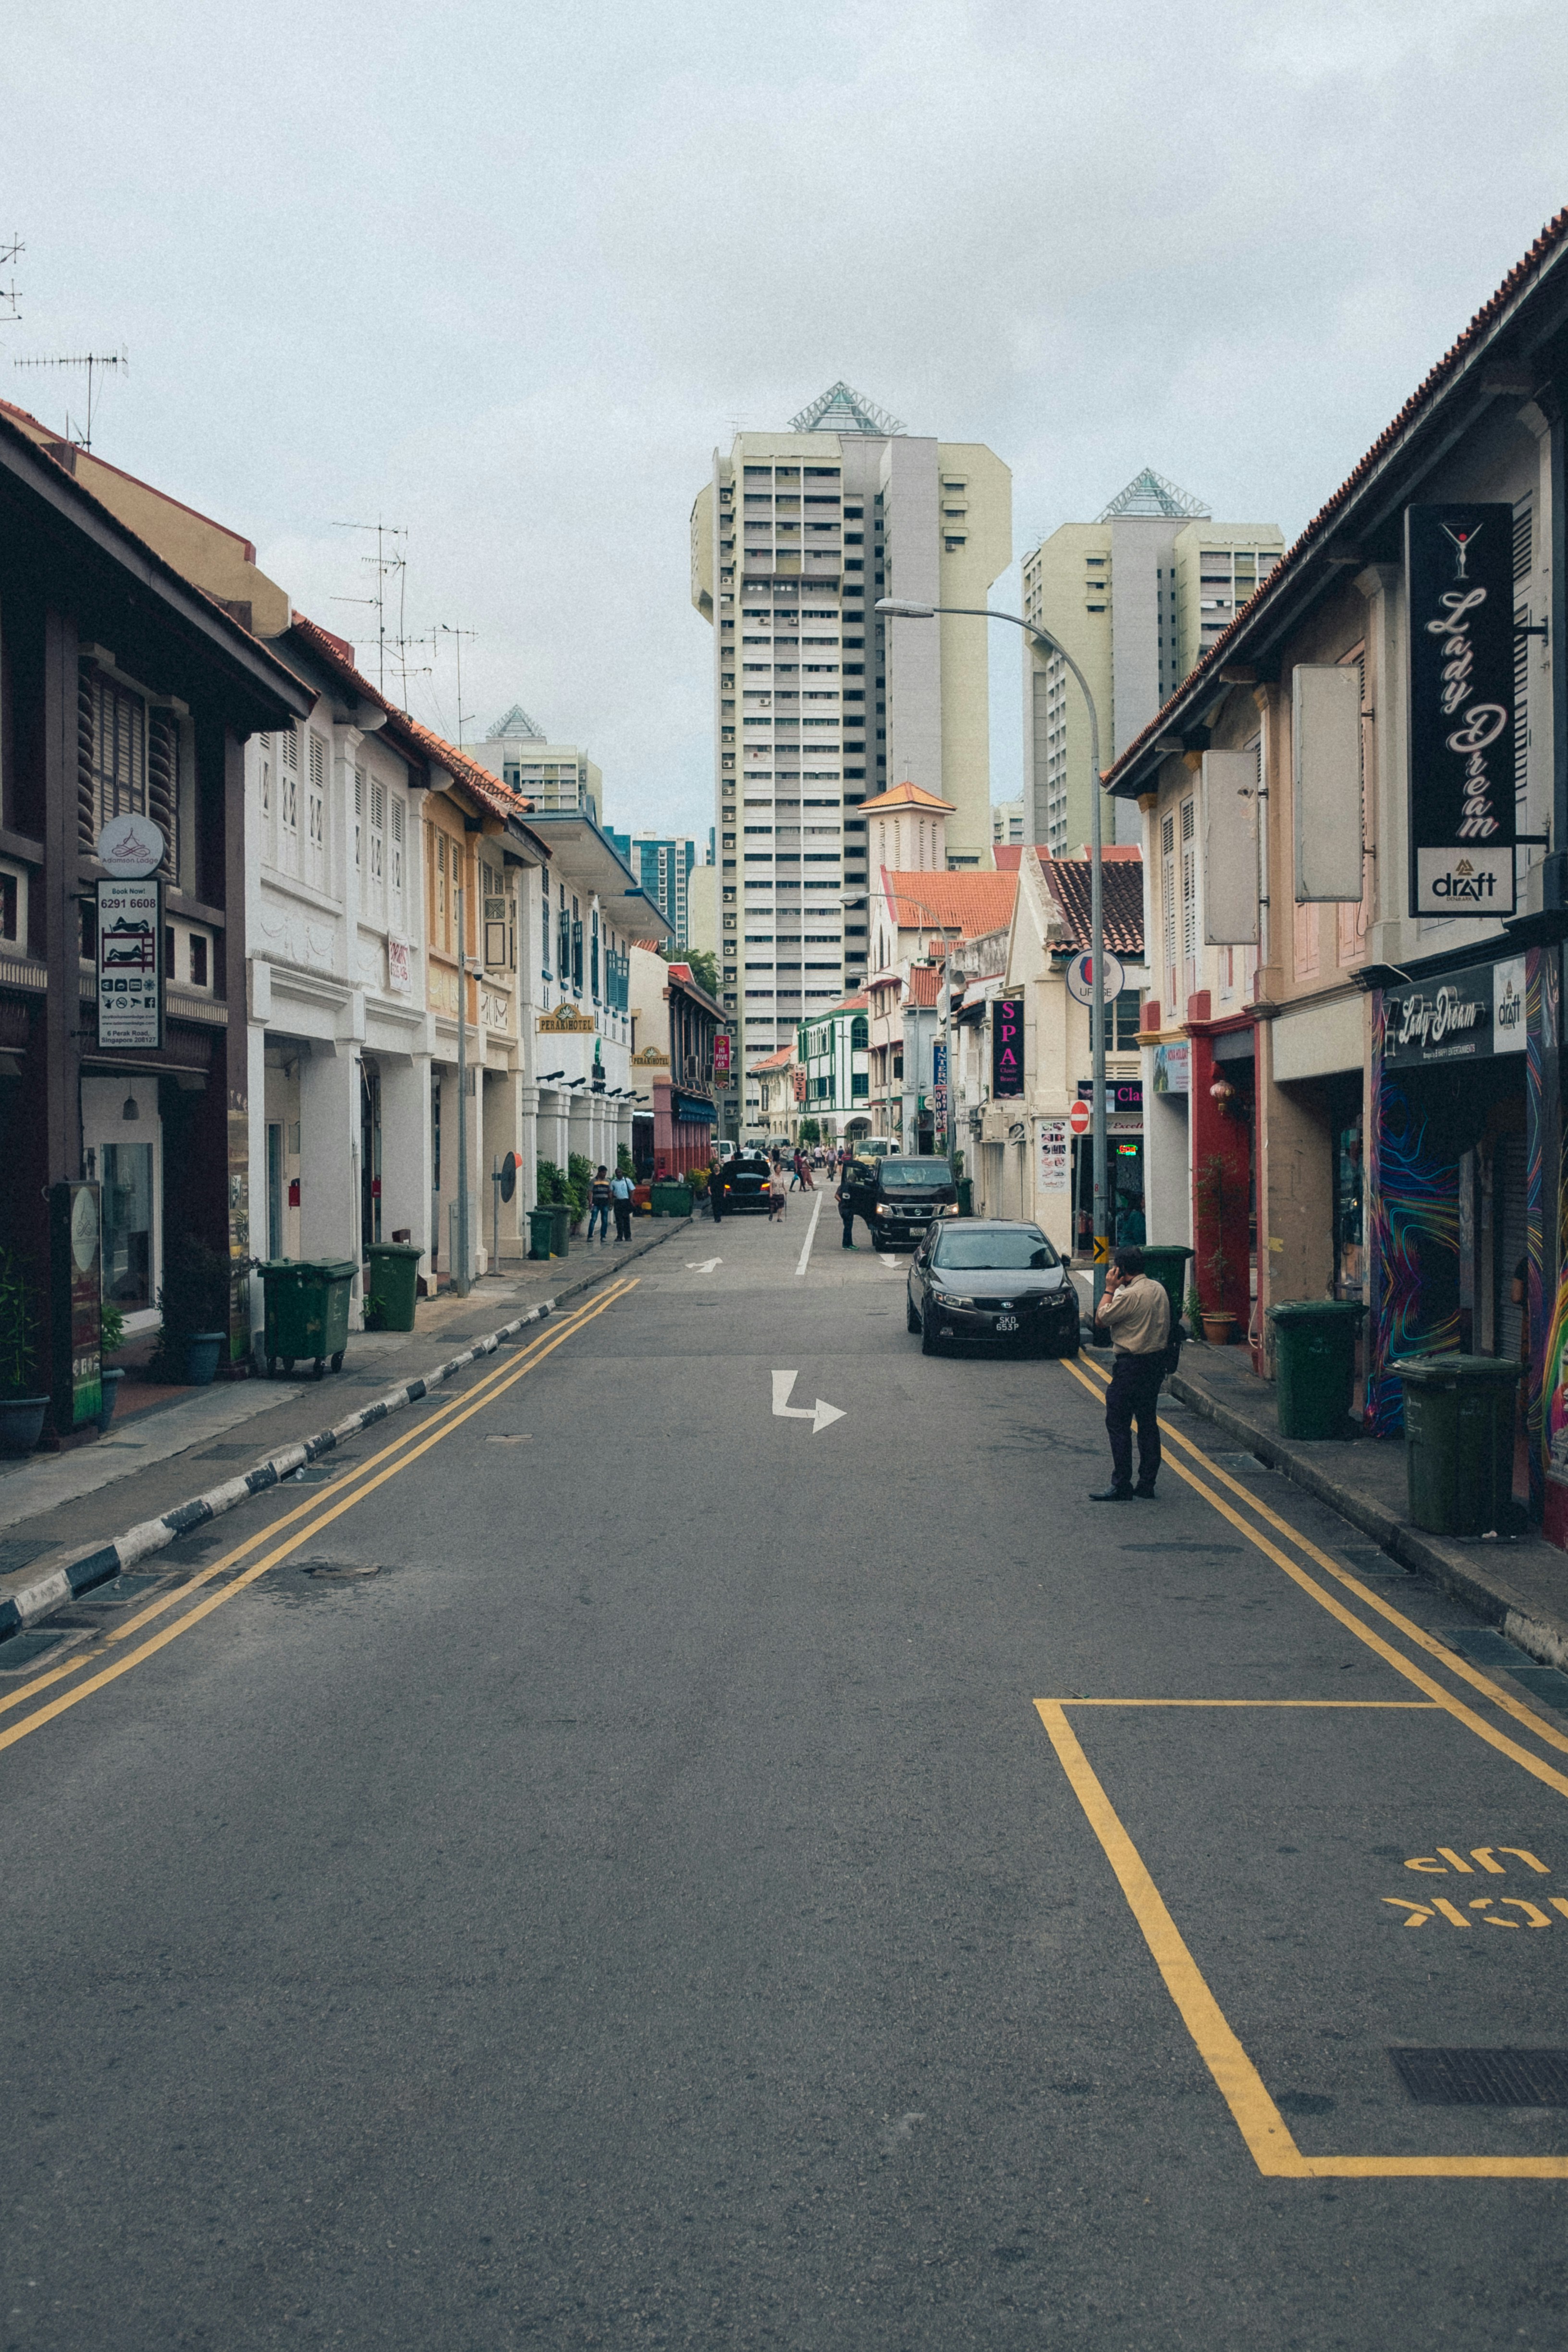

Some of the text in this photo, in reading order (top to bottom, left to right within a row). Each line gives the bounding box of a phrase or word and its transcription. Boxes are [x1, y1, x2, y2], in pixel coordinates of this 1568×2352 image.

[1425, 587, 1508, 838] Lady Dream
[101, 898, 156, 908] 6291 6608
[541, 1020, 592, 1030] PERAK HOTEL
[1399, 986, 1476, 1047] Lady Dream
[1000, 1002, 1017, 1065] SPA
[937, 1046, 947, 1084] INTERN
[795, 1073, 805, 1102] HOSTEL
[1404, 1847, 1552, 1873] UP
